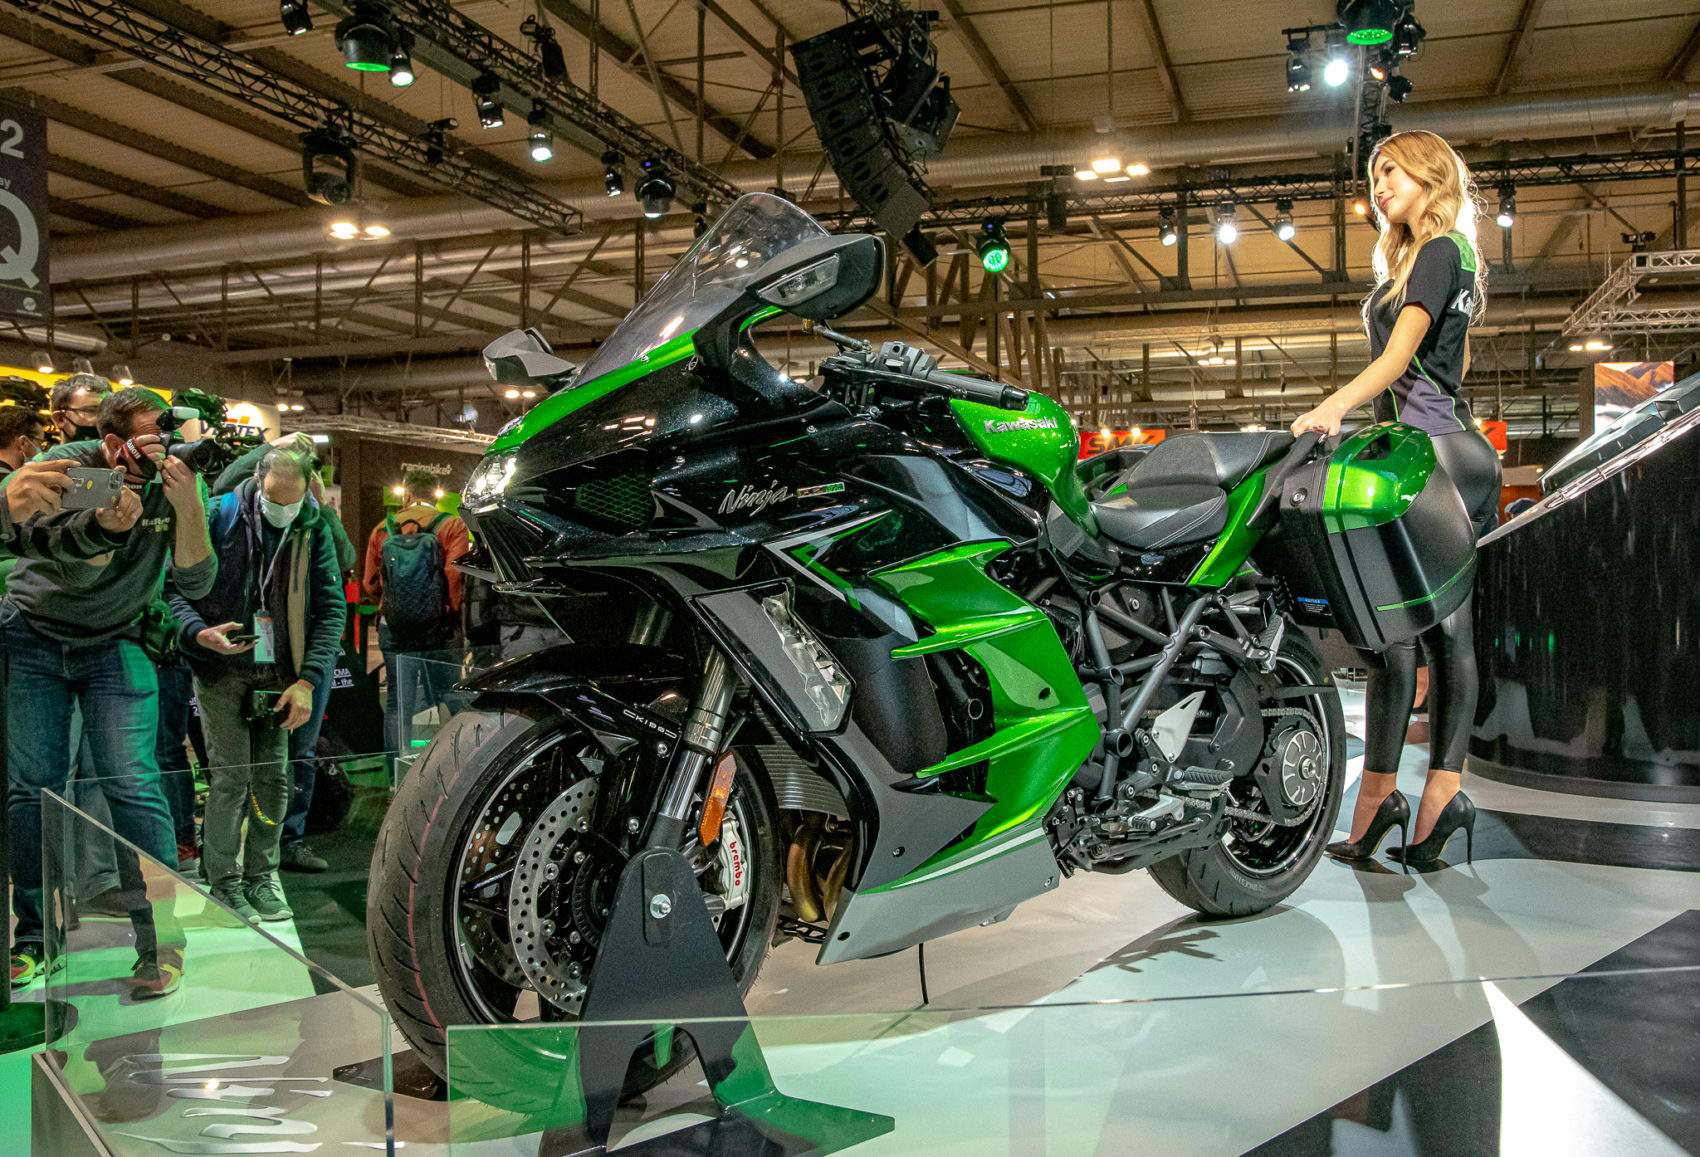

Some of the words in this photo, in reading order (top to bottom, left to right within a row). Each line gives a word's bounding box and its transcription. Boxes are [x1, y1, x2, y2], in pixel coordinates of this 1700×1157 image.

[200, 419, 272, 438] VTEX
[984, 415, 1059, 434] Kawasaki
[718, 479, 794, 517] Ninja
[729, 840, 743, 887] brembo
